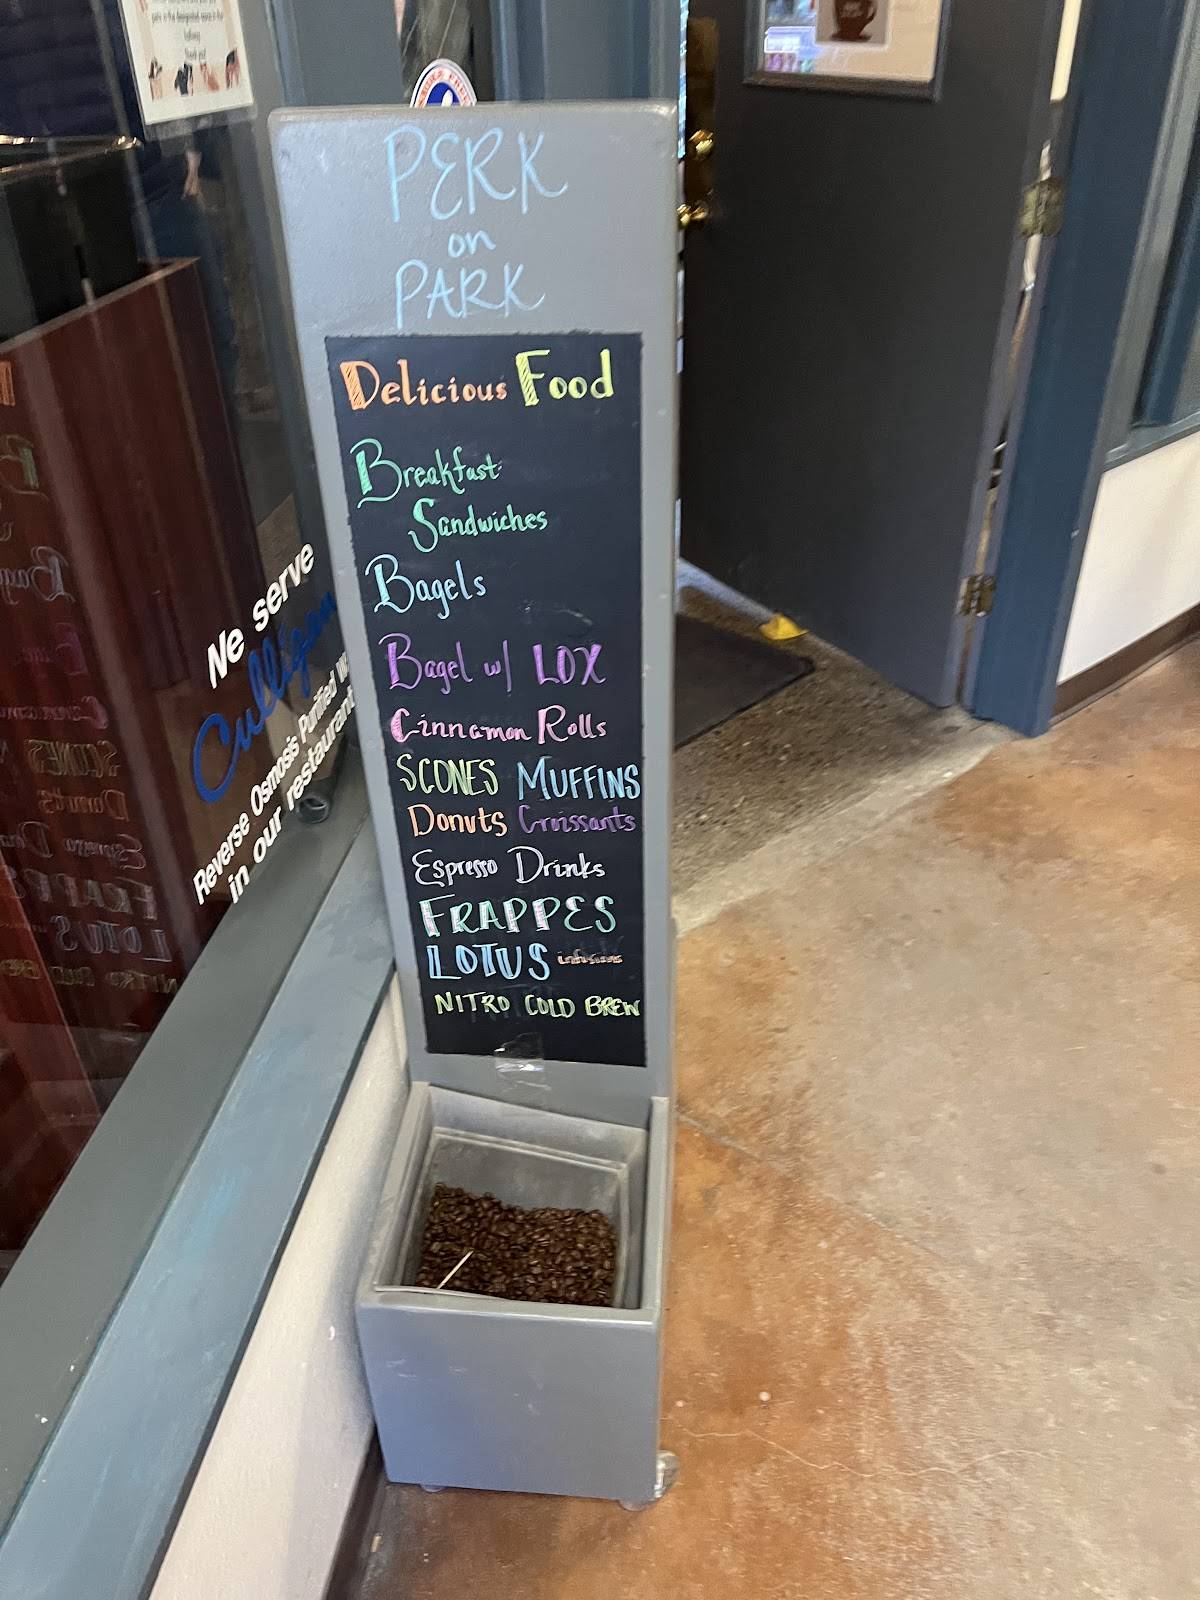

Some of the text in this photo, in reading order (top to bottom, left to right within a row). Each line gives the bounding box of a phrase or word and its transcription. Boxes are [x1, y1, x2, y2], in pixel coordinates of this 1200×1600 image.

[384, 125, 568, 222] PERK
[447, 230, 496, 258] on
[395, 259, 546, 329] PARK
[339, 348, 614, 411] Delicious Food
[350, 438, 502, 509] Breakfast
[408, 498, 548, 552] Sandwiches
[252, 543, 315, 632] serve
[365, 554, 486, 619] Bagels
[378, 632, 473, 694] Bagel
[484, 640, 512, 697] w/
[533, 643, 606, 686] LOX
[390, 704, 607, 745] Cinnamon Rolls
[228, 864, 250, 904] in
[253, 806, 282, 863] our
[286, 684, 355, 812] restaurant
[396, 753, 641, 800] SCONES MUFFINS
[193, 812, 250, 905] Reverse
[250, 735, 300, 817] Osmosis
[407, 803, 636, 837] Donuts Croissants
[411, 846, 606, 887] Espresso Drinks
[419, 894, 616, 937] FRAPPES
[427, 943, 550, 980] LOTUS
[434, 991, 641, 1018] NITRO COLD BREW
